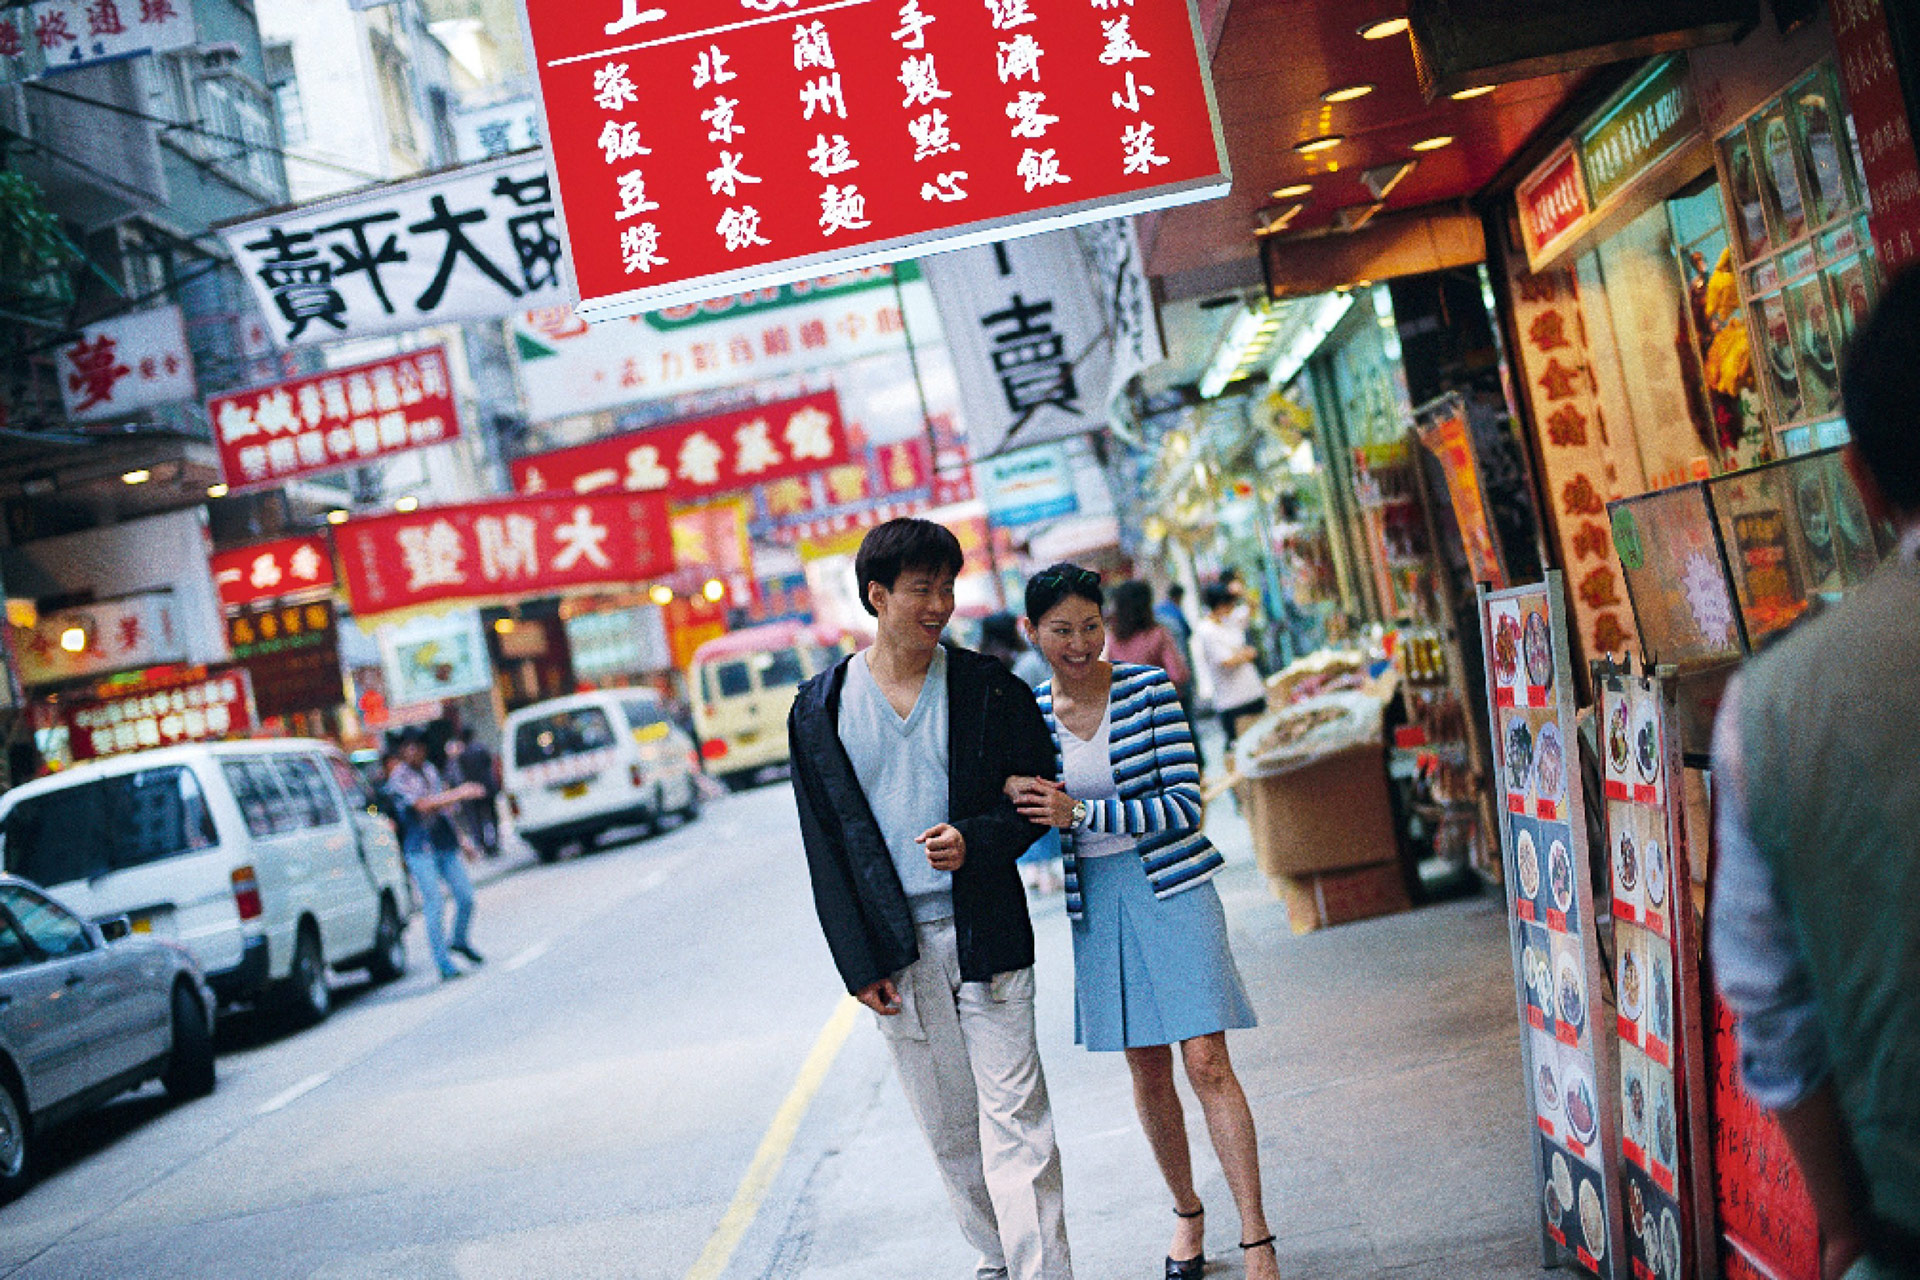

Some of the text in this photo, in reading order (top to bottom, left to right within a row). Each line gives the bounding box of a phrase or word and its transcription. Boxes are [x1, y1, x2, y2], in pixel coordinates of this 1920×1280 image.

[690, 44, 772, 252] 北京水餃
[890, 0, 969, 203] 手製點心
[1091, 0, 1171, 175] 美小菜
